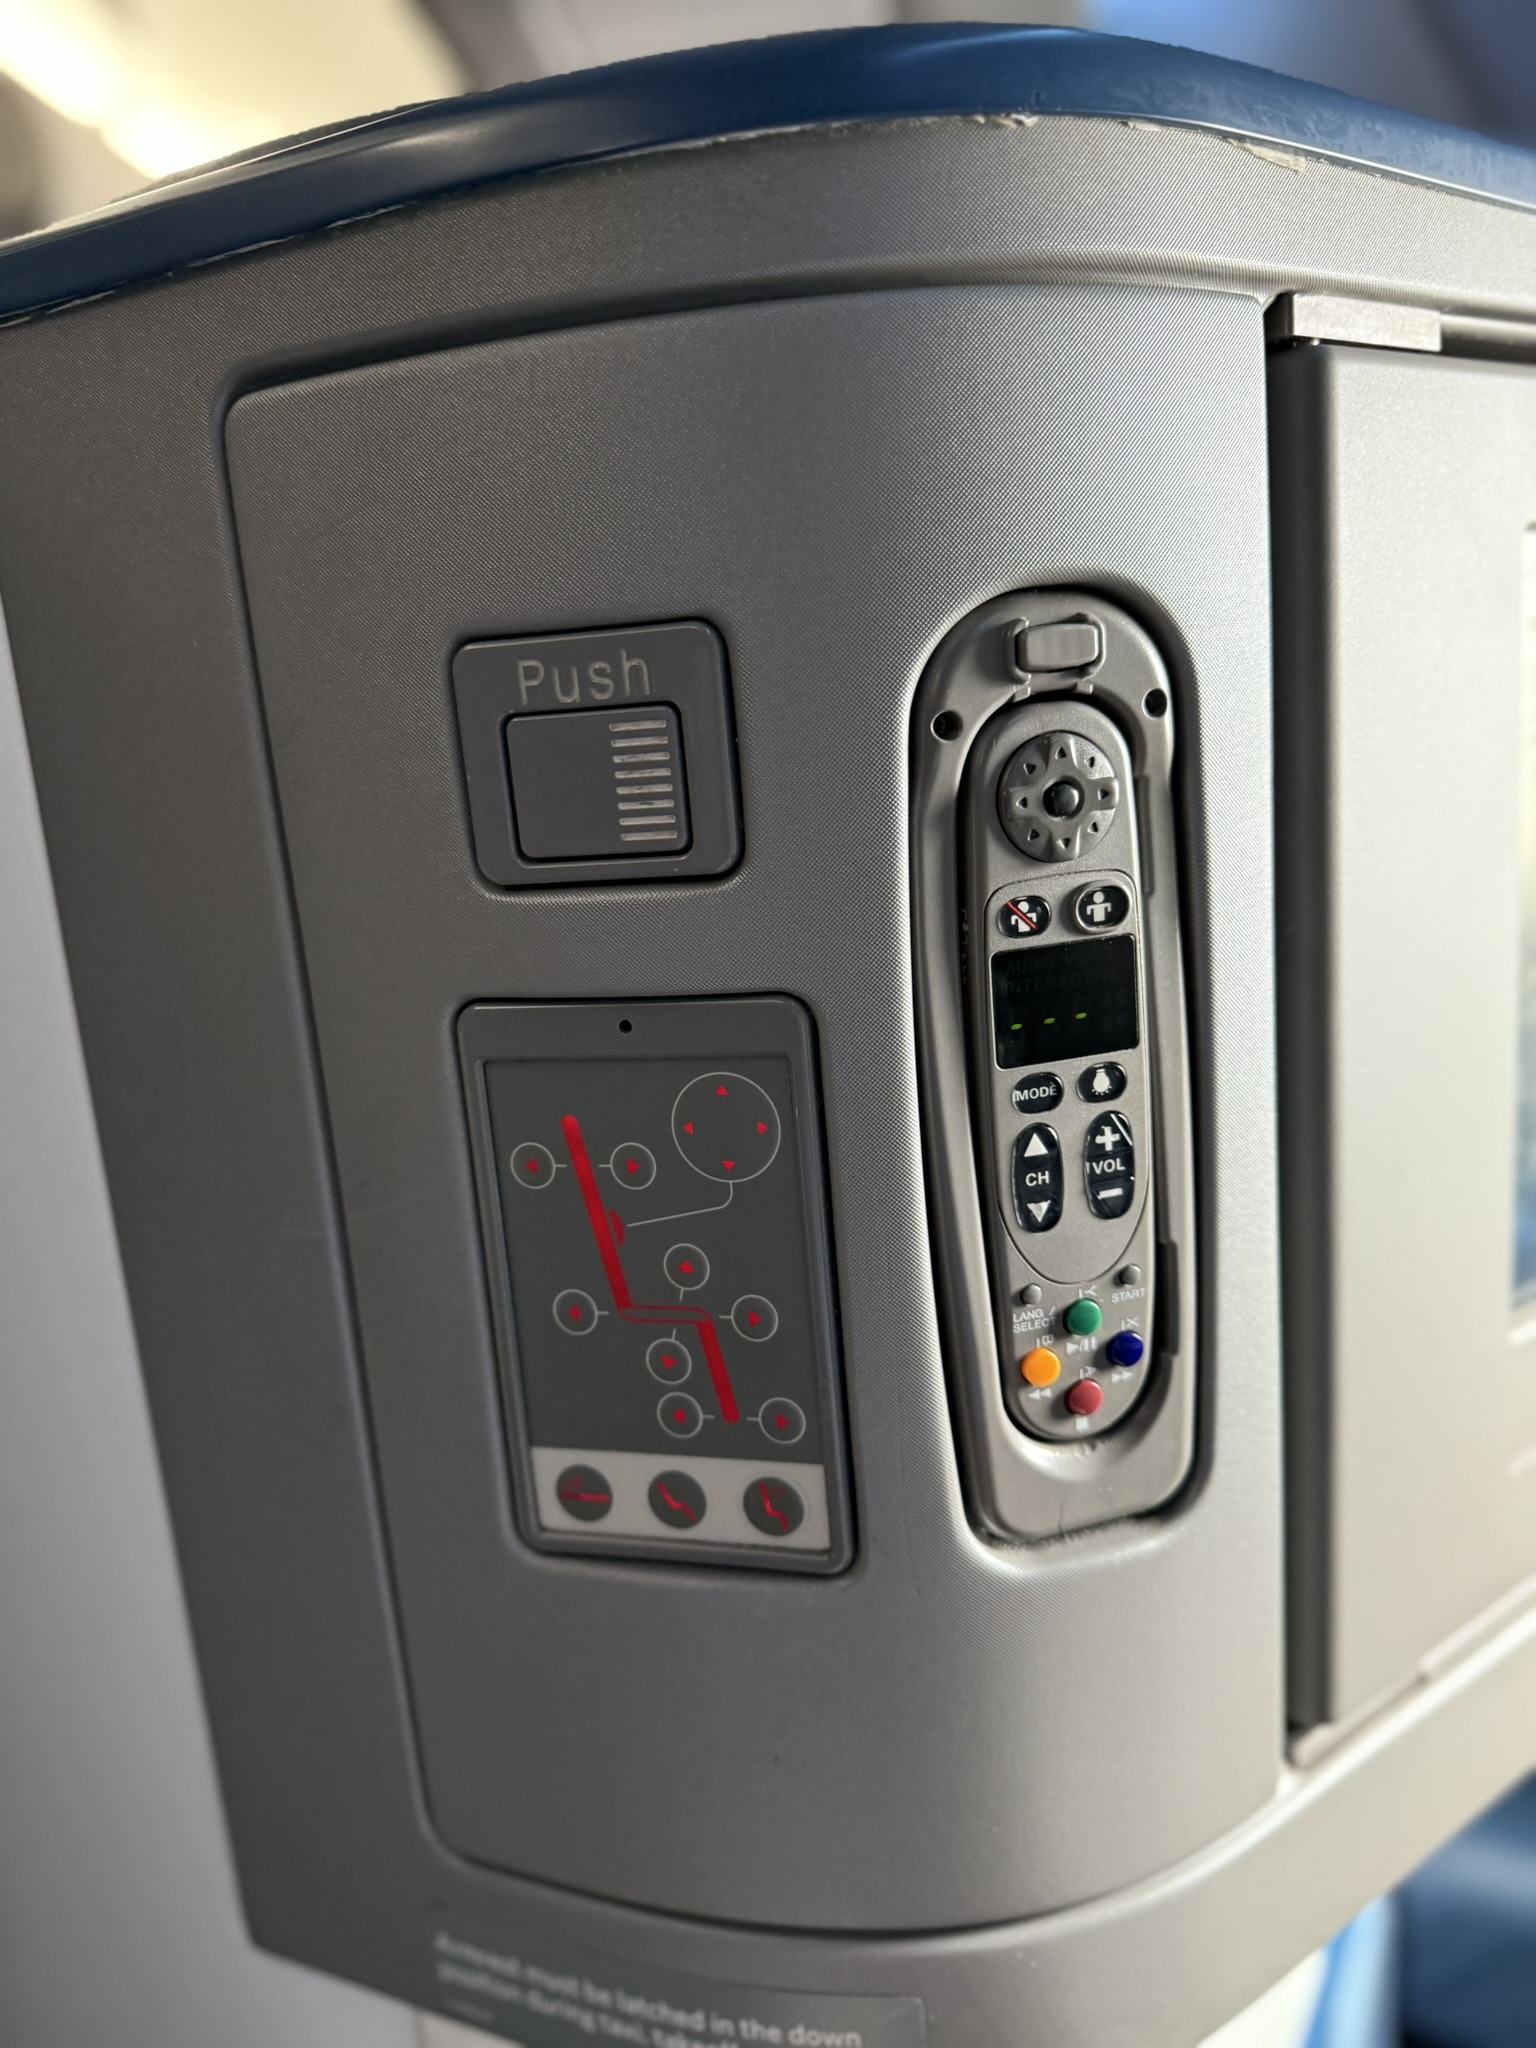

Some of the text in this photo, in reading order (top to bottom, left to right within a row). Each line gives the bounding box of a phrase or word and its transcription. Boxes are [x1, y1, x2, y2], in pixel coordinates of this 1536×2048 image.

[517, 649, 650, 706] Push
[1015, 1083, 1058, 1102] MODE
[1092, 1158, 1126, 1175] VOL
[1025, 1170, 1050, 1187] CH
[1111, 1287, 1146, 1303] START
[1012, 1316, 1056, 1334] SELECT
[523, 1965, 579, 1998] must
[582, 1977, 612, 2008] be
[615, 1987, 706, 2032] latched
[709, 2012, 735, 2036] in
[738, 2018, 784, 2044] the
[788, 2023, 863, 2048] down
[524, 1989, 596, 2034] during
